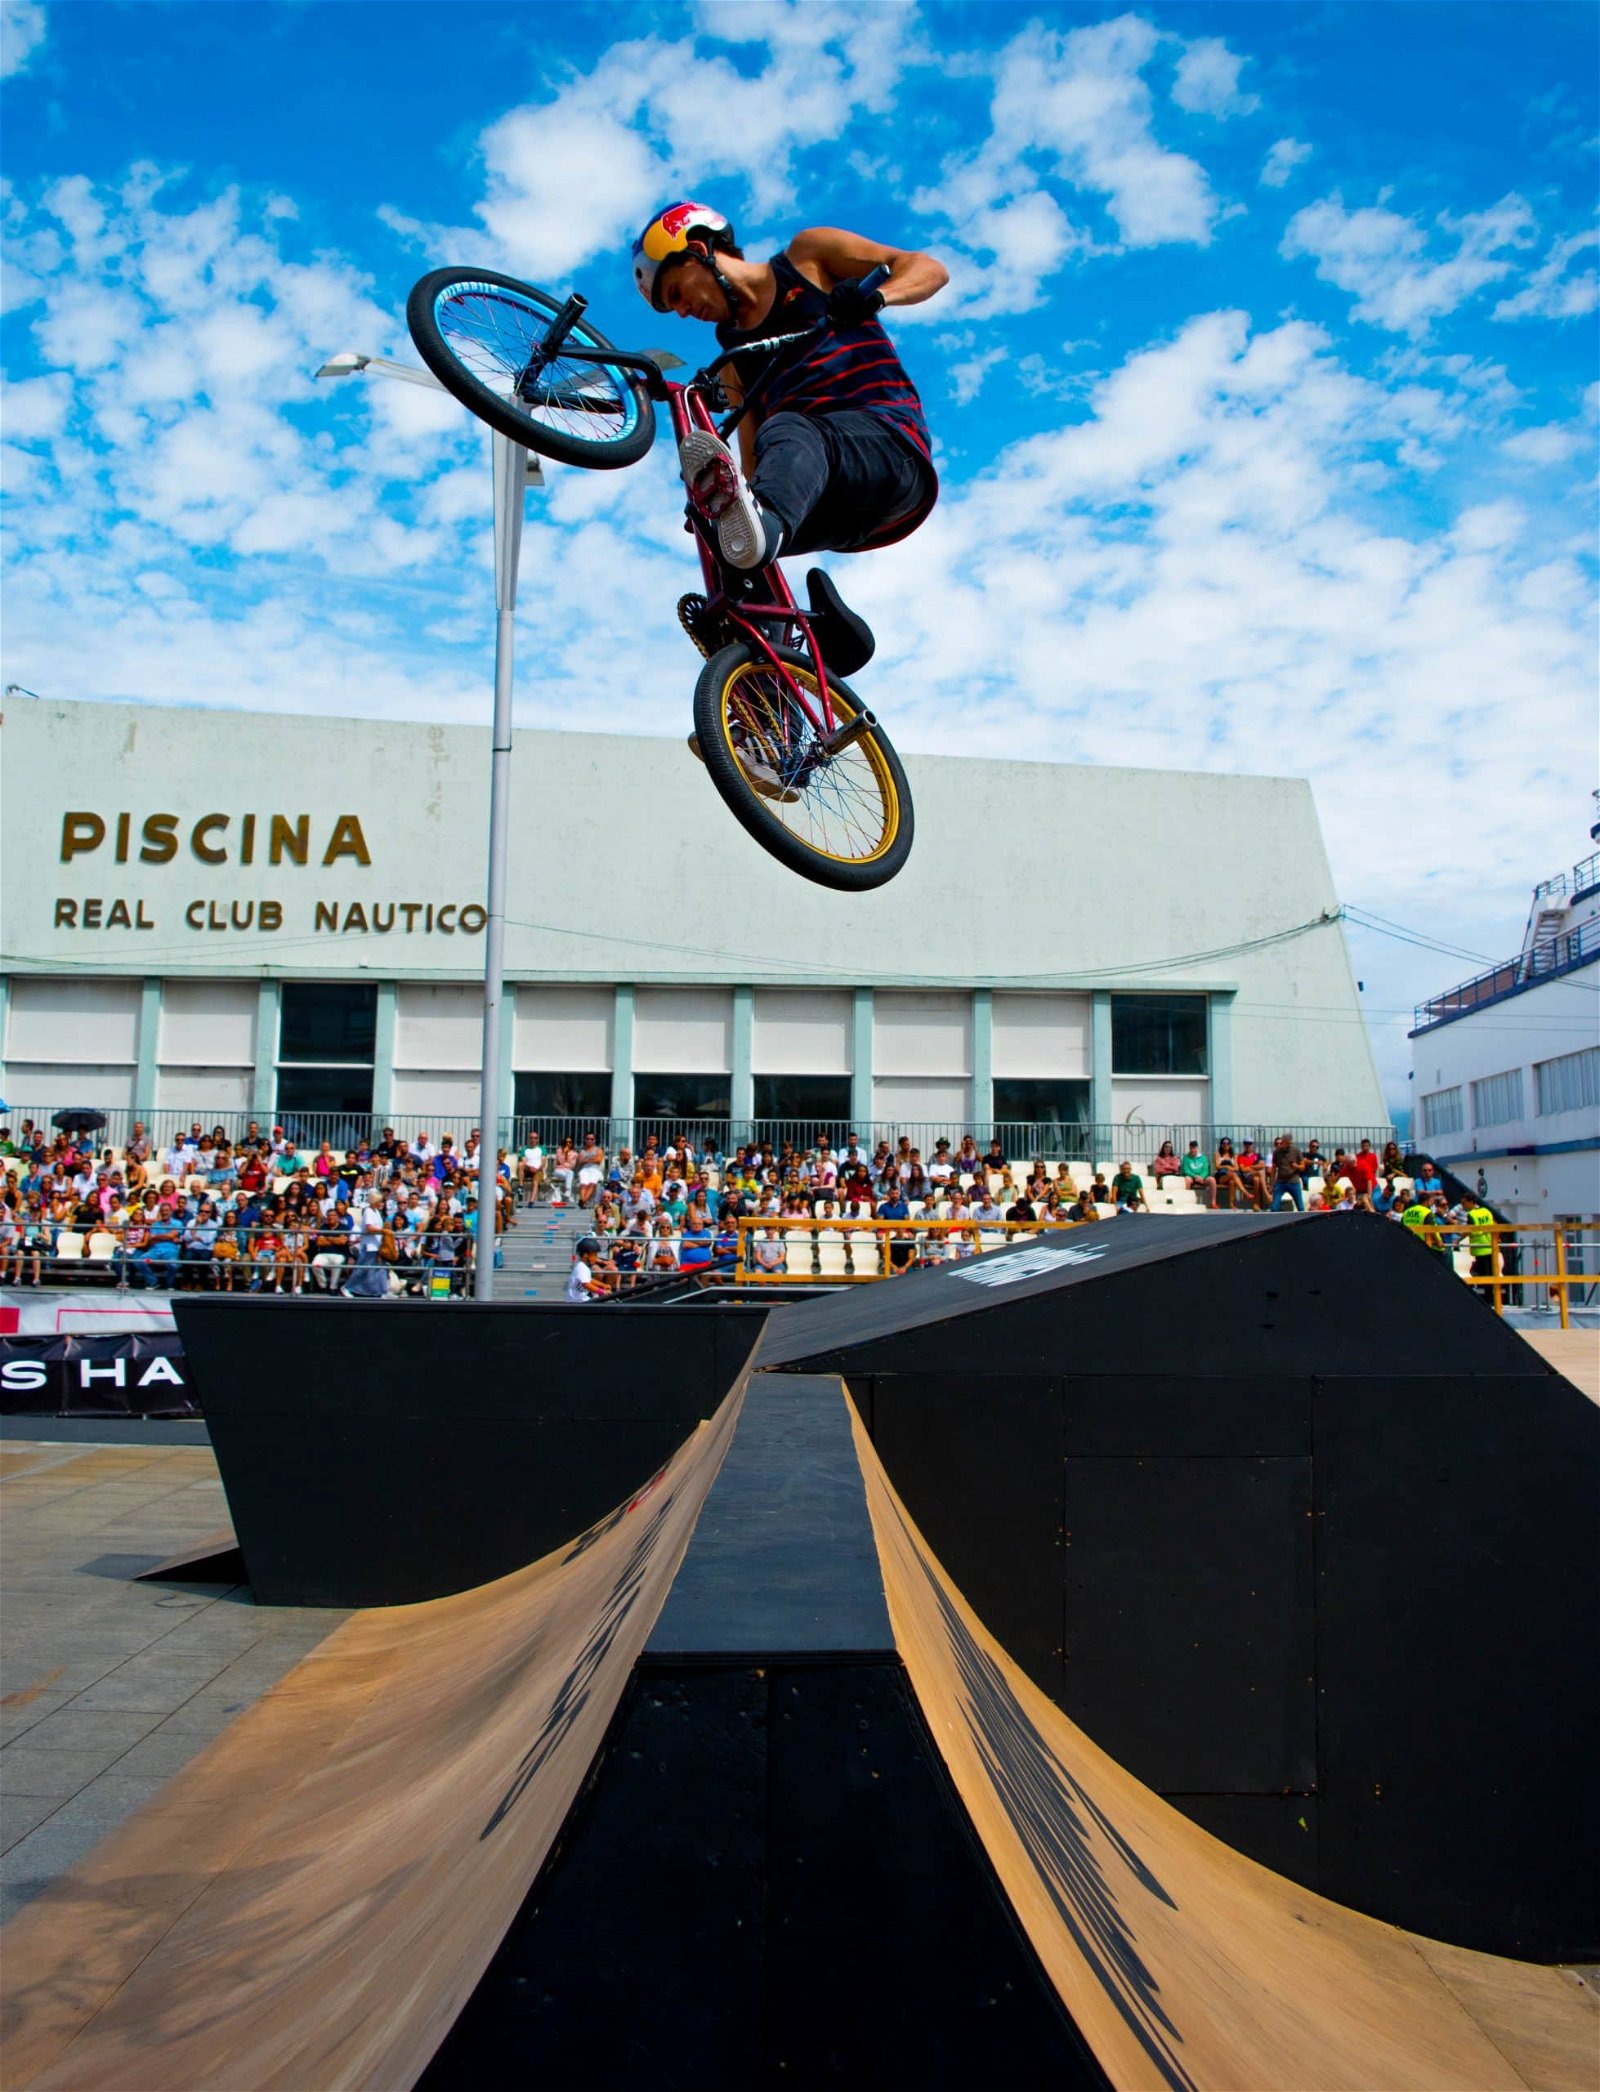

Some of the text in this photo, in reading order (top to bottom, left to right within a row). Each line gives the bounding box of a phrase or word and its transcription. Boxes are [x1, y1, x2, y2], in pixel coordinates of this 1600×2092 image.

[60, 811, 371, 866] PISCINA
[54, 898, 487, 934] REAL CLUB NAUTICO
